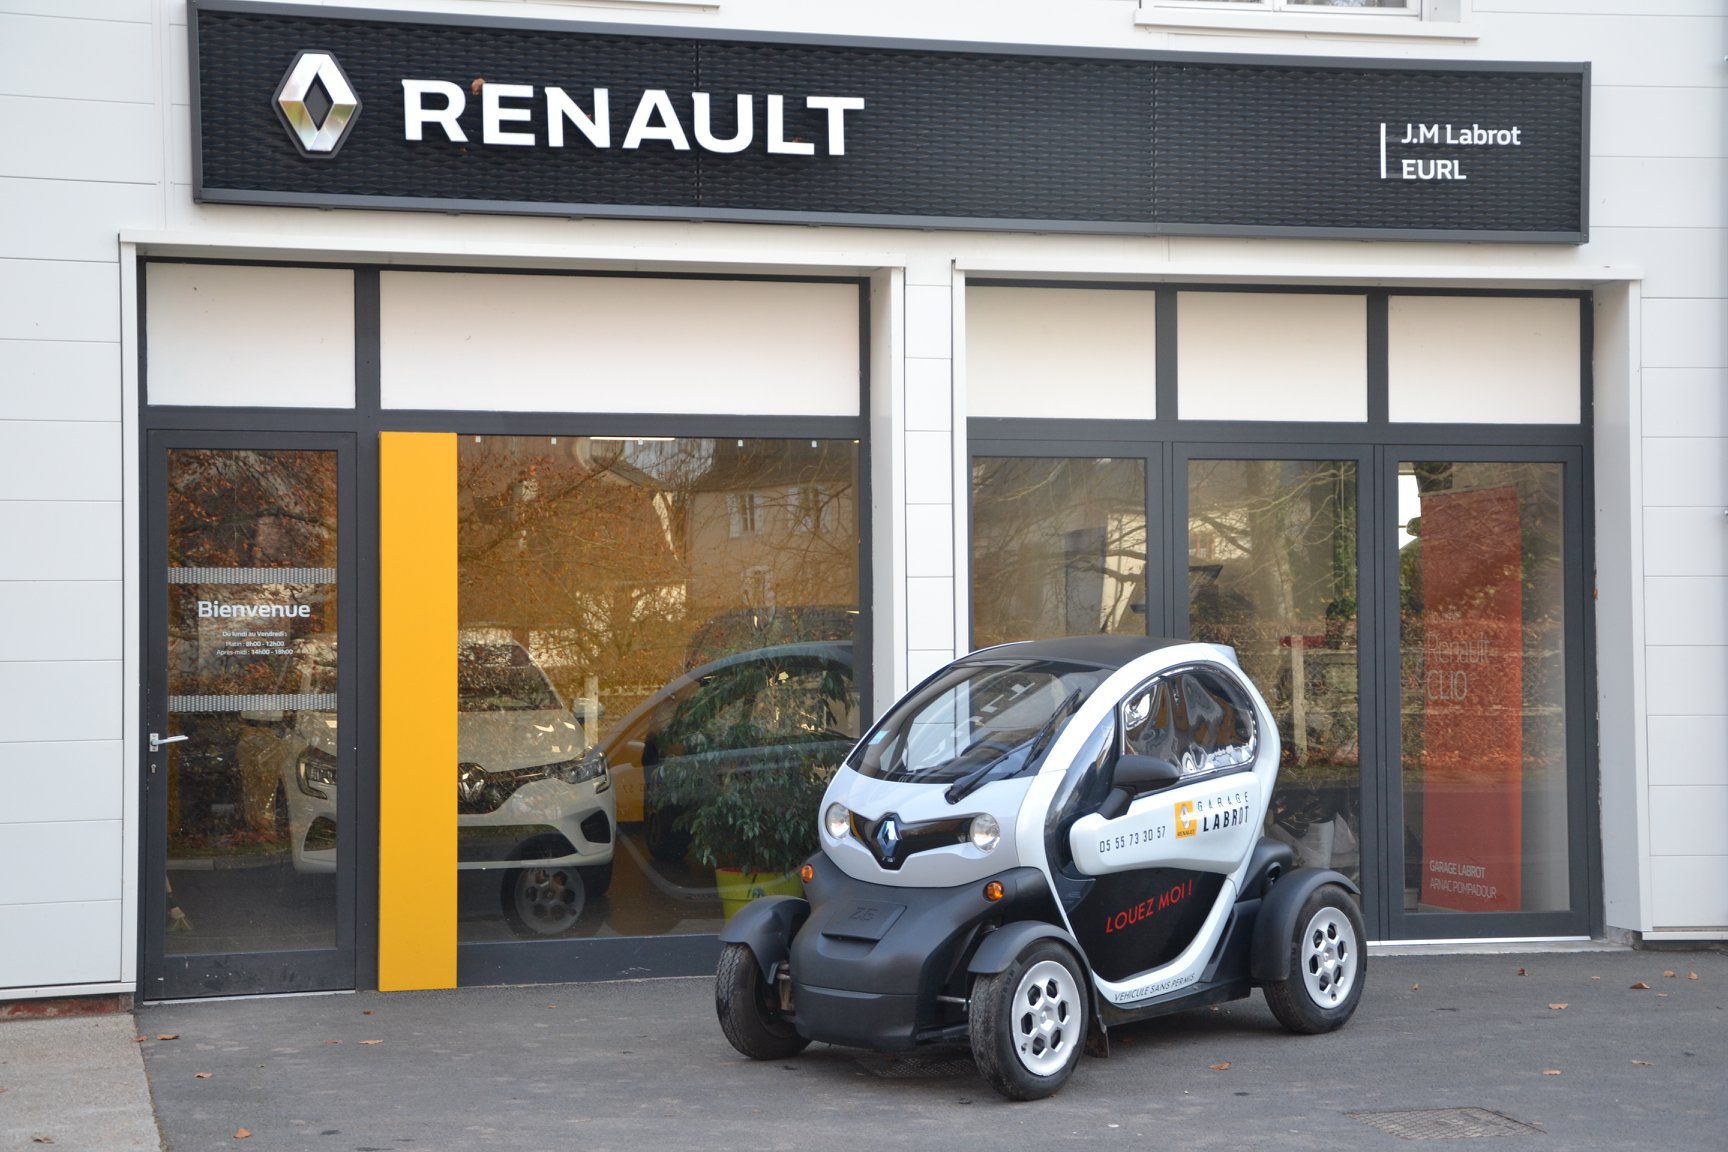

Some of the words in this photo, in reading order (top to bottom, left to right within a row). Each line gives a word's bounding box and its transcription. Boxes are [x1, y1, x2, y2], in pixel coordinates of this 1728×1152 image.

[401, 78, 865, 156] RENAULT
[1401, 123, 1439, 144] J.M
[1446, 123, 1522, 146] Labrot
[1401, 159, 1467, 180] EURL
[197, 600, 311, 618] Bienvenue
[1427, 669, 1467, 700] CLIO
[1197, 791, 1249, 811] GARAGE
[1202, 805, 1249, 832] LABROT
[1099, 839, 1111, 853] 05
[1115, 835, 1125, 849] 55
[1129, 832, 1139, 846] 73
[1143, 828, 1153, 842] 30
[1156, 825, 1166, 839] 57
[1429, 860, 1457, 875] GARAGE
[1458, 864, 1486, 879] LABROT
[1106, 896, 1154, 933] LOUEZ
[1158, 882, 1185, 911] MOI
[1150, 981, 1170, 994] SANS
